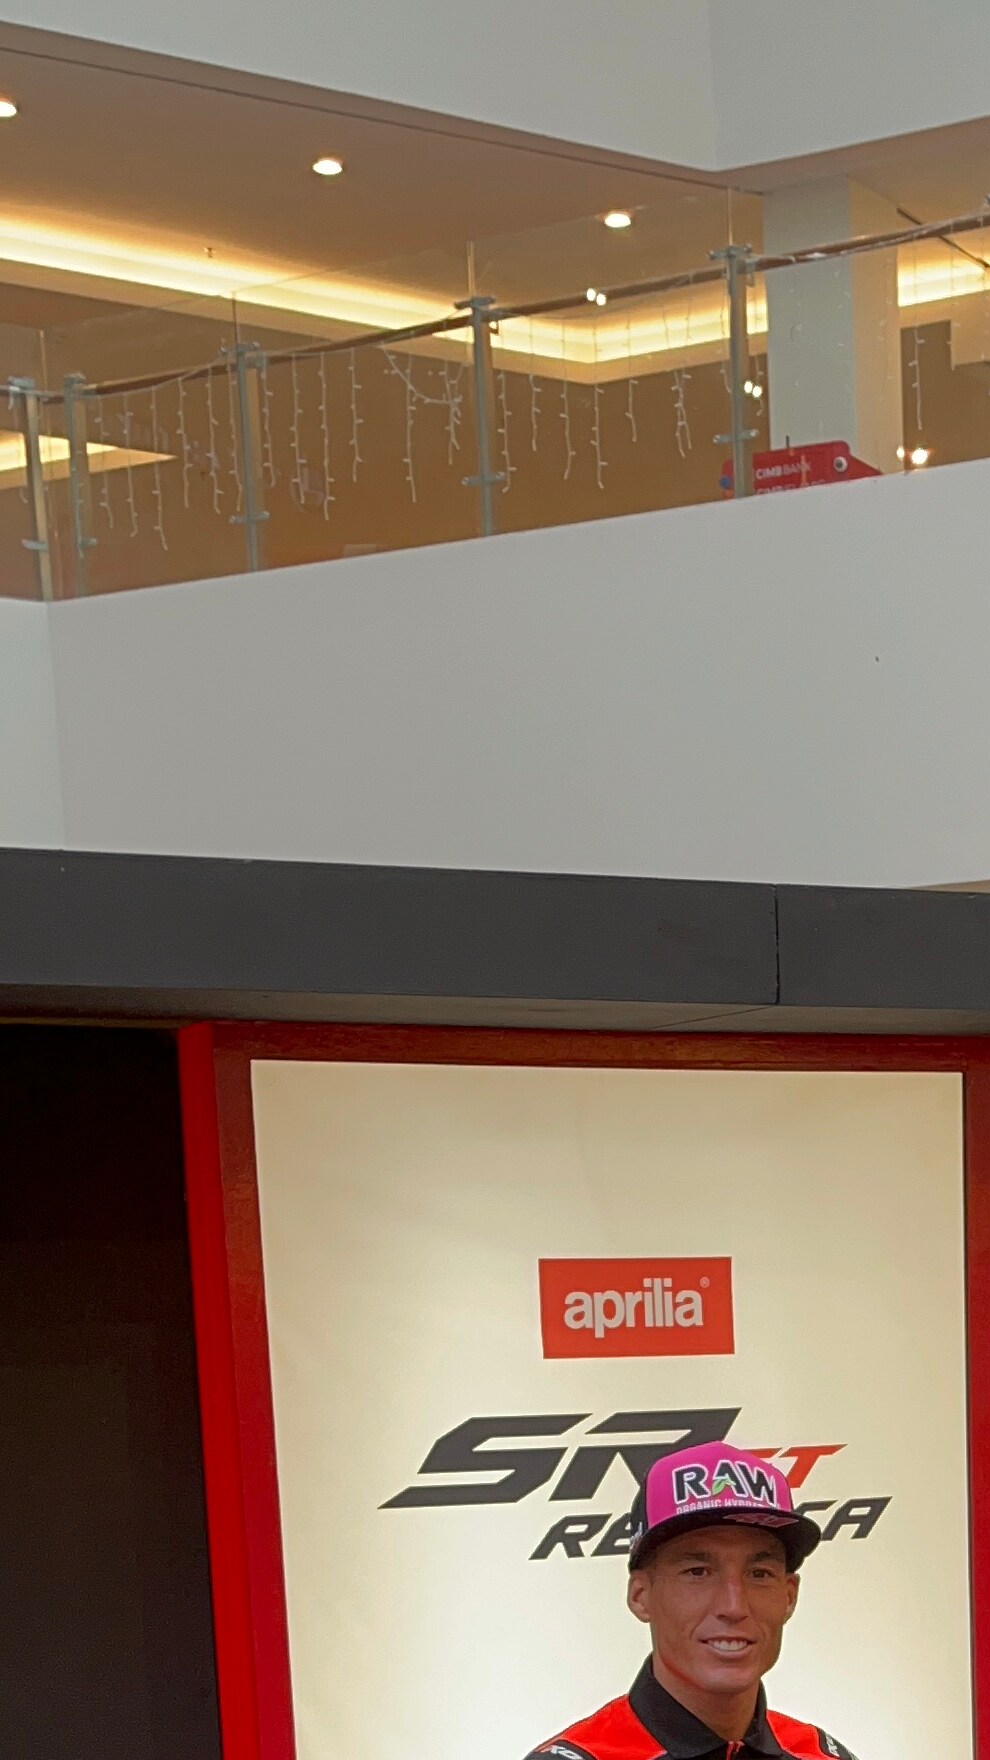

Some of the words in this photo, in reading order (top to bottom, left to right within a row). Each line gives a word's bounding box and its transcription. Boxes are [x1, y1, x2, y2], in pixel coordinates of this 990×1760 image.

[563, 1278, 704, 1339] aprilia
[377, 1407, 742, 1509] SR
[672, 1460, 779, 1505] RAW
